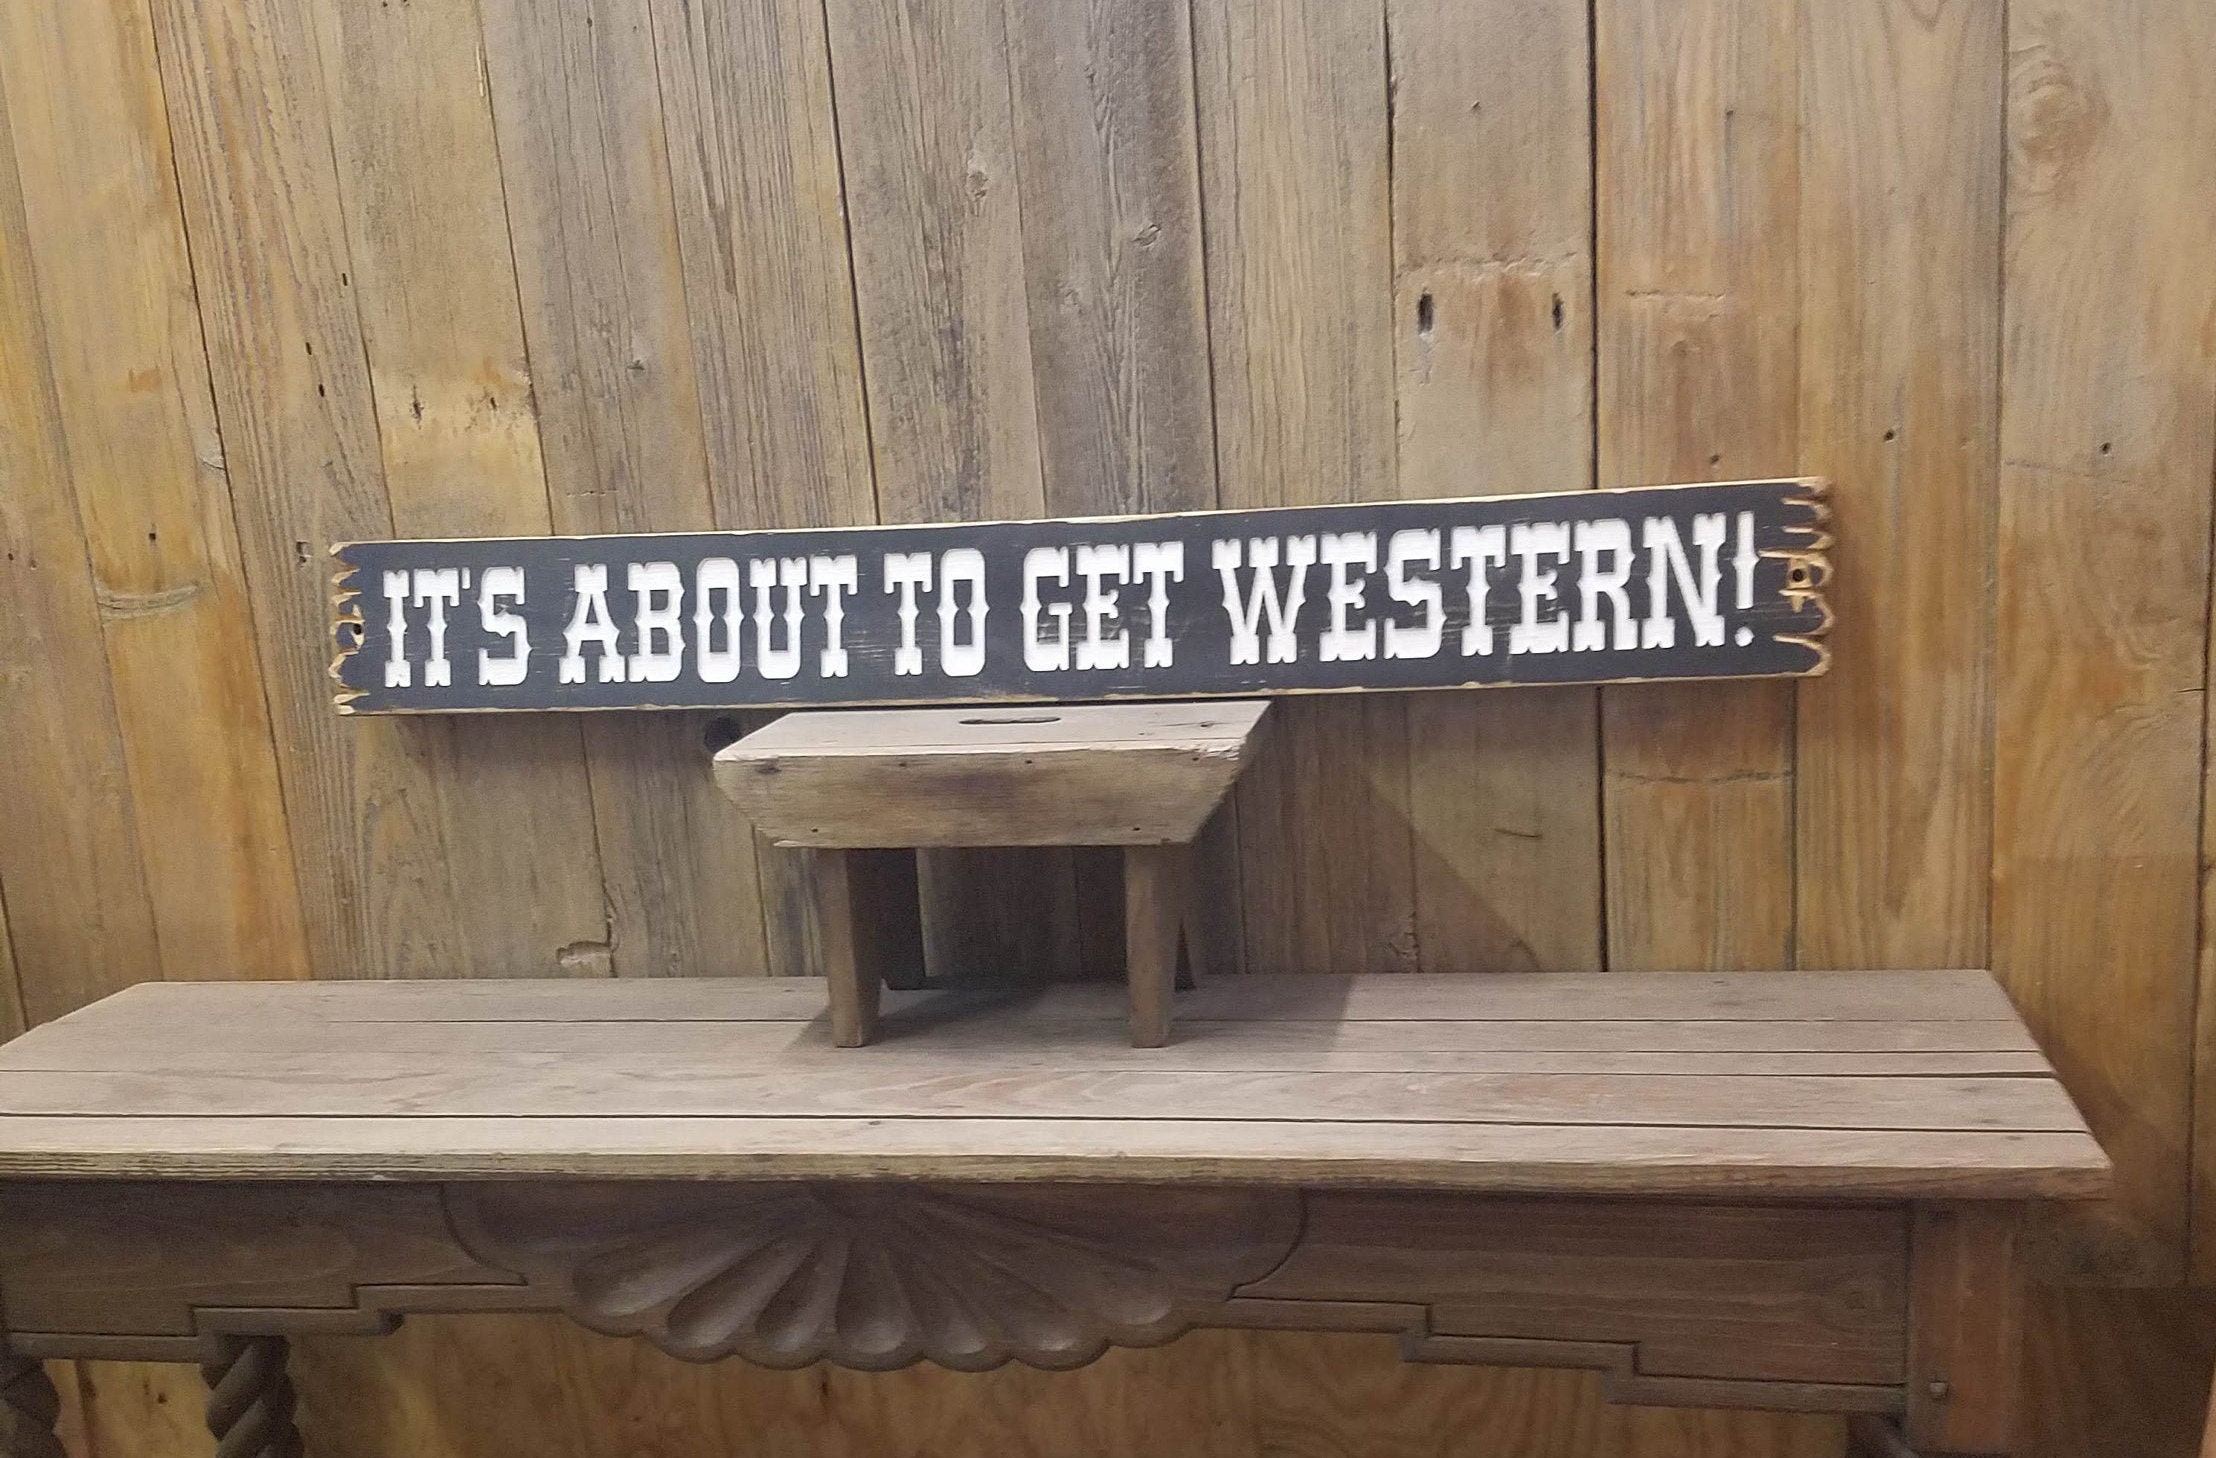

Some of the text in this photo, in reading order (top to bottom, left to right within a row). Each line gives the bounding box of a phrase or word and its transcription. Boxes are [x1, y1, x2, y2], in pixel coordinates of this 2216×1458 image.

[382, 511, 1759, 687] IT'S ABOUT TO GET WESTERN!
